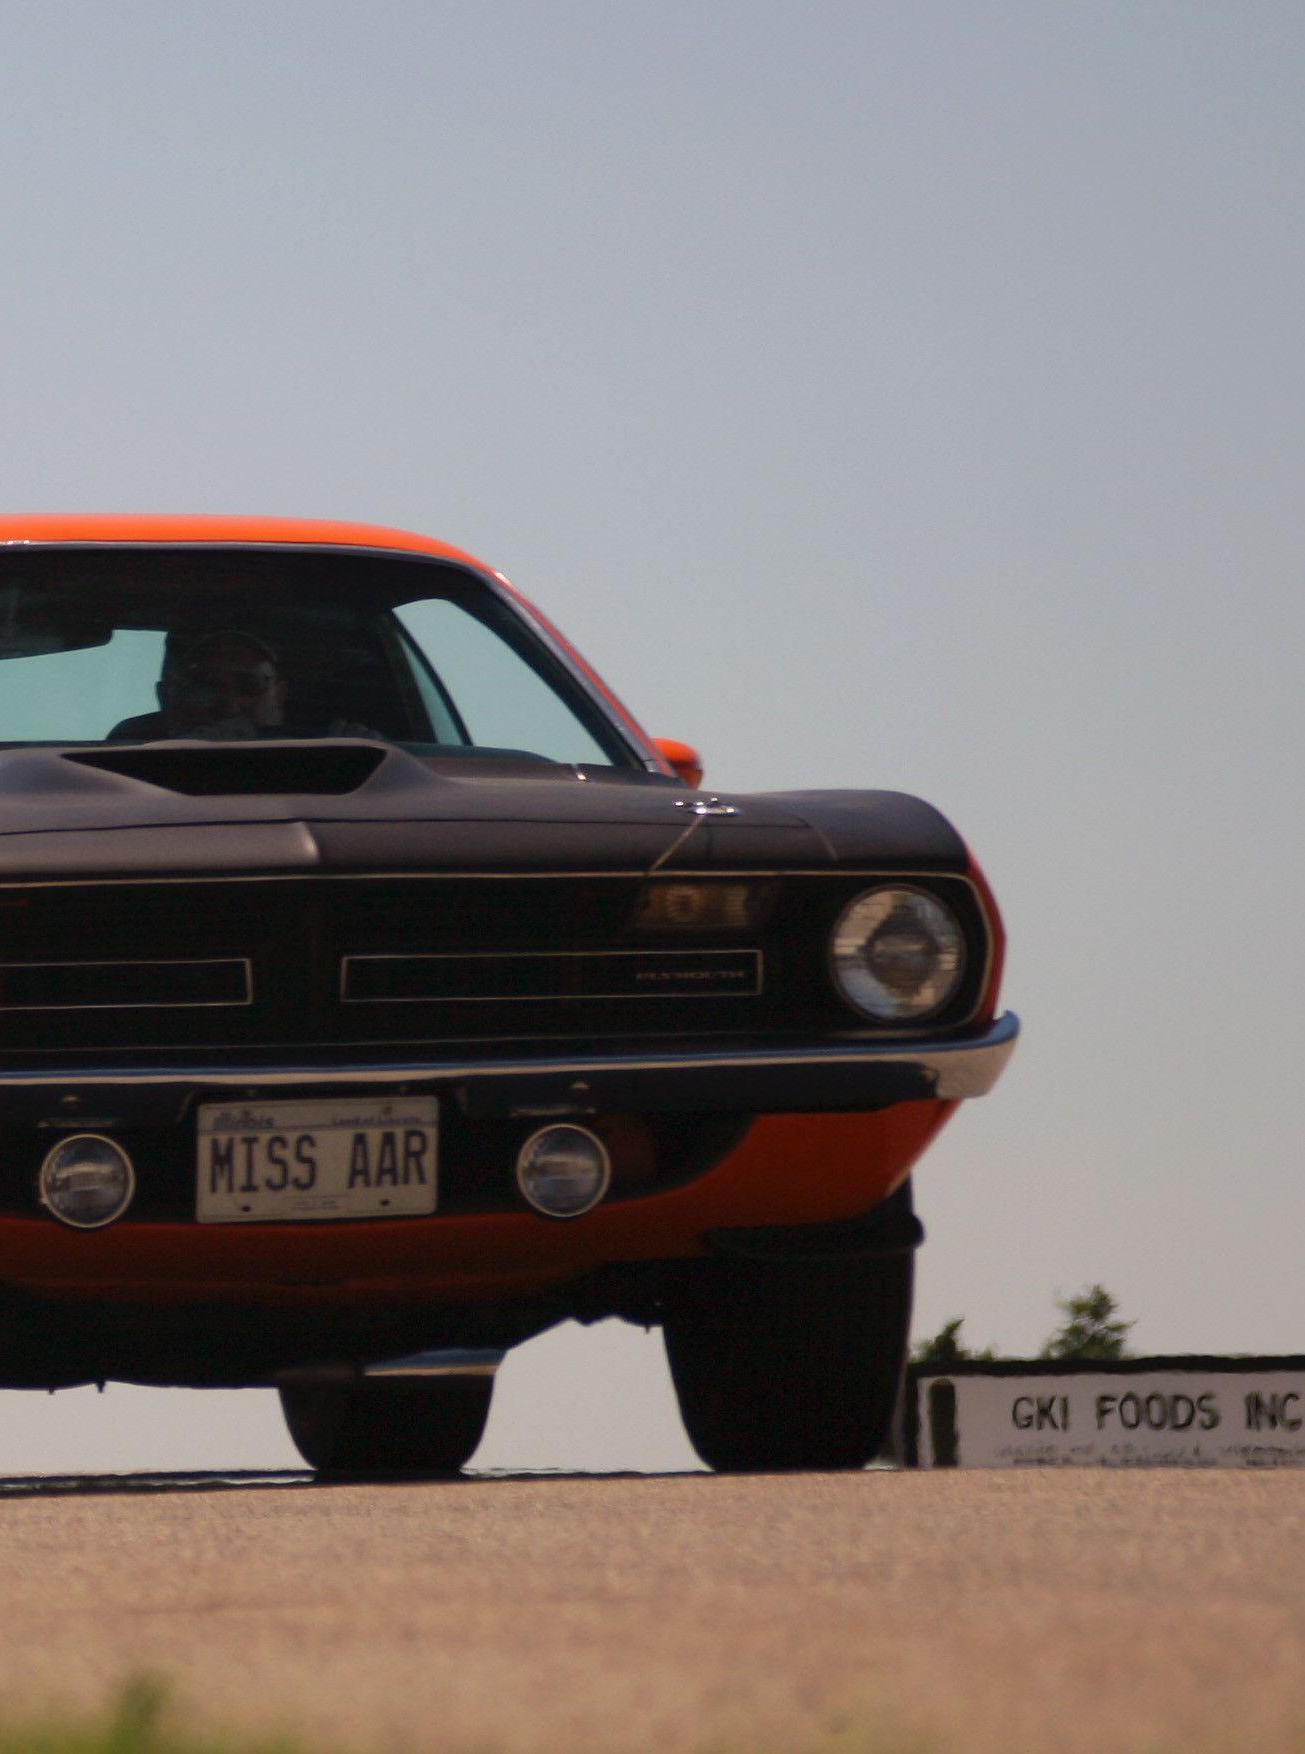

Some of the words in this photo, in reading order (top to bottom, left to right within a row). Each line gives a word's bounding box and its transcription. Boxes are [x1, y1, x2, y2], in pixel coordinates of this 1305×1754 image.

[210, 1134, 317, 1193] MISS
[348, 1130, 427, 1188] AAR
[1011, 1395, 1070, 1431] GKI
[1097, 1391, 1220, 1431] FOODS
[1244, 1391, 1303, 1432] INC
